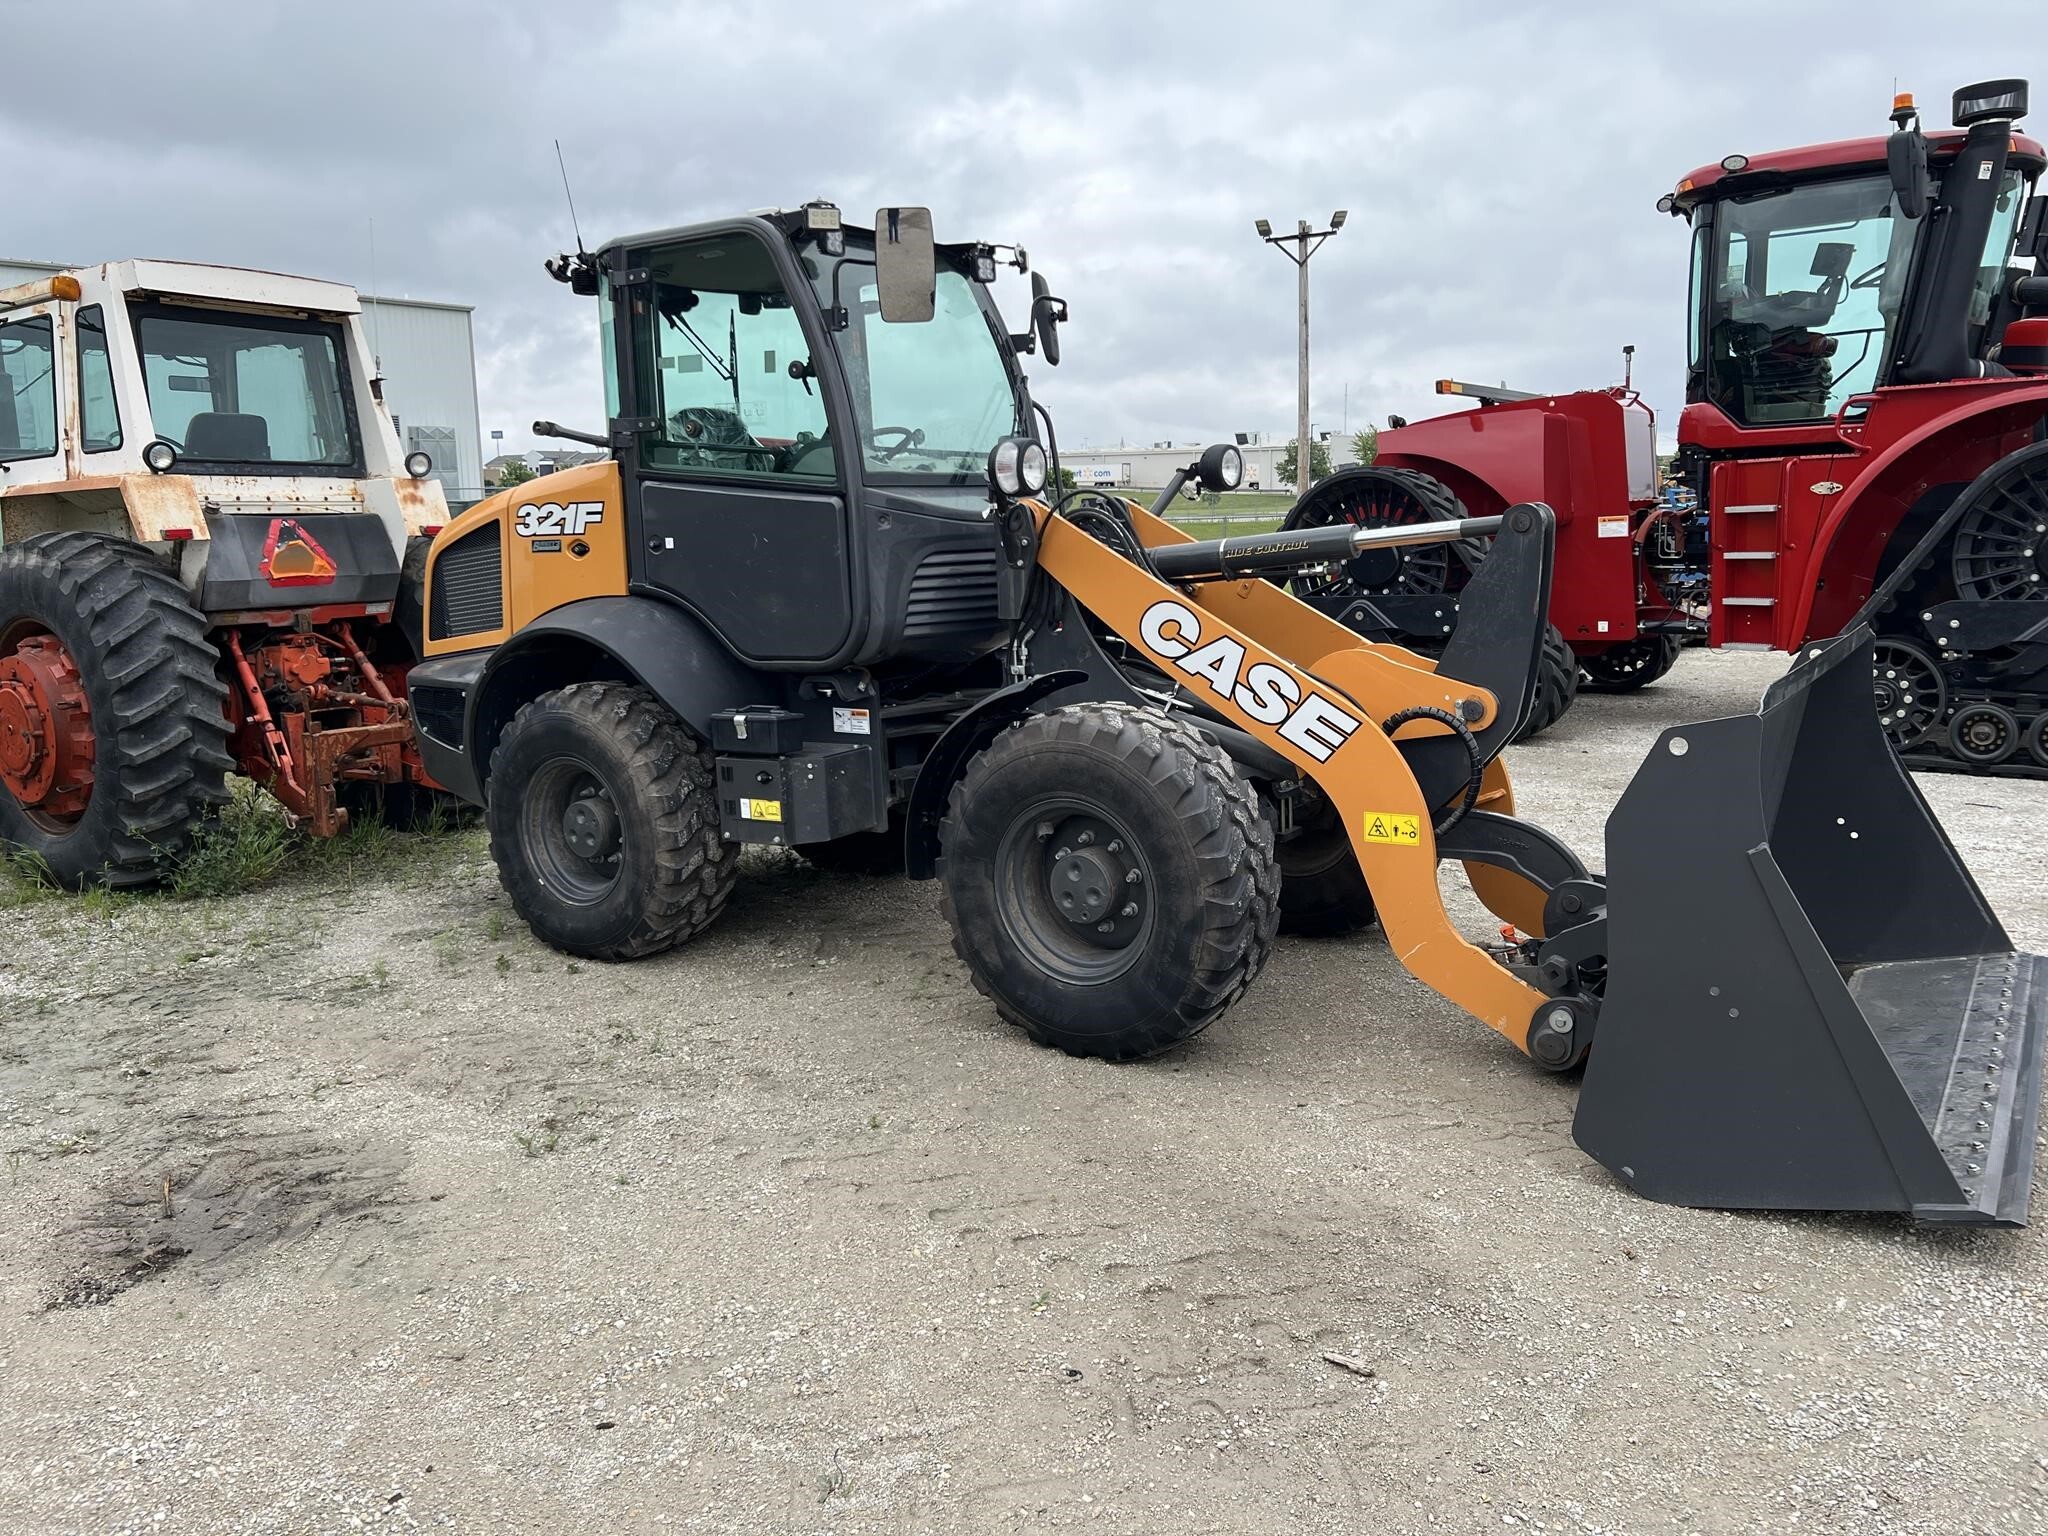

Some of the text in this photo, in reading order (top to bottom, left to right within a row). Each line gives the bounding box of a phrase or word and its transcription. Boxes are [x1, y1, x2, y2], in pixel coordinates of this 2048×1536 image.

[515, 501, 605, 537] 321F
[1225, 540, 1309, 558] RIDE CONTROL
[1139, 600, 1362, 764] CASE
